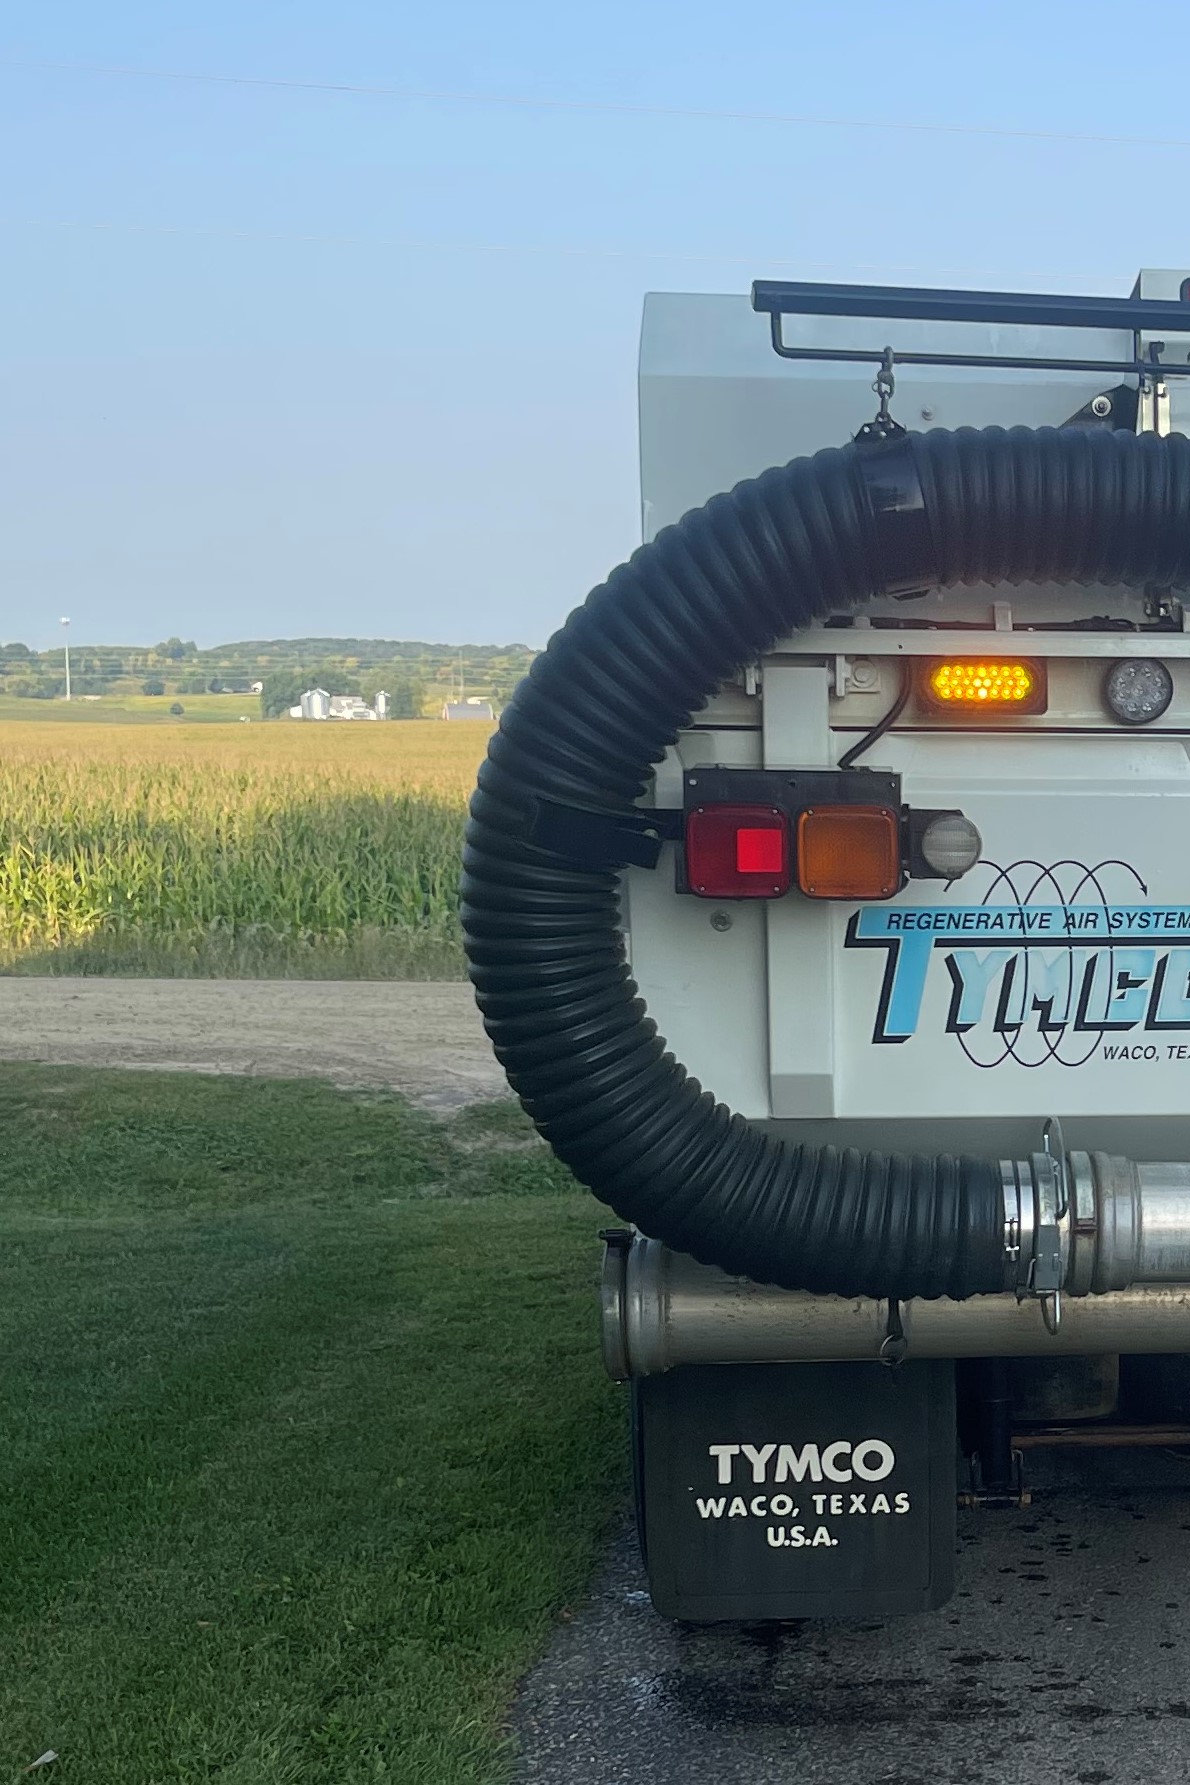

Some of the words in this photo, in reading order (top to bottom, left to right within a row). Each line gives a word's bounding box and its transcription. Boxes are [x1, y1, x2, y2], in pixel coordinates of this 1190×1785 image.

[887, 912, 1052, 930] REGENERATIVE
[1063, 912, 1098, 929] AIR
[1102, 1046, 1160, 1062] WACO,
[709, 1439, 895, 1484] TYMCO
[696, 1494, 800, 1518] WACO,
[811, 1492, 910, 1515] TEXAS
[767, 1526, 839, 1547] U.S.A.
